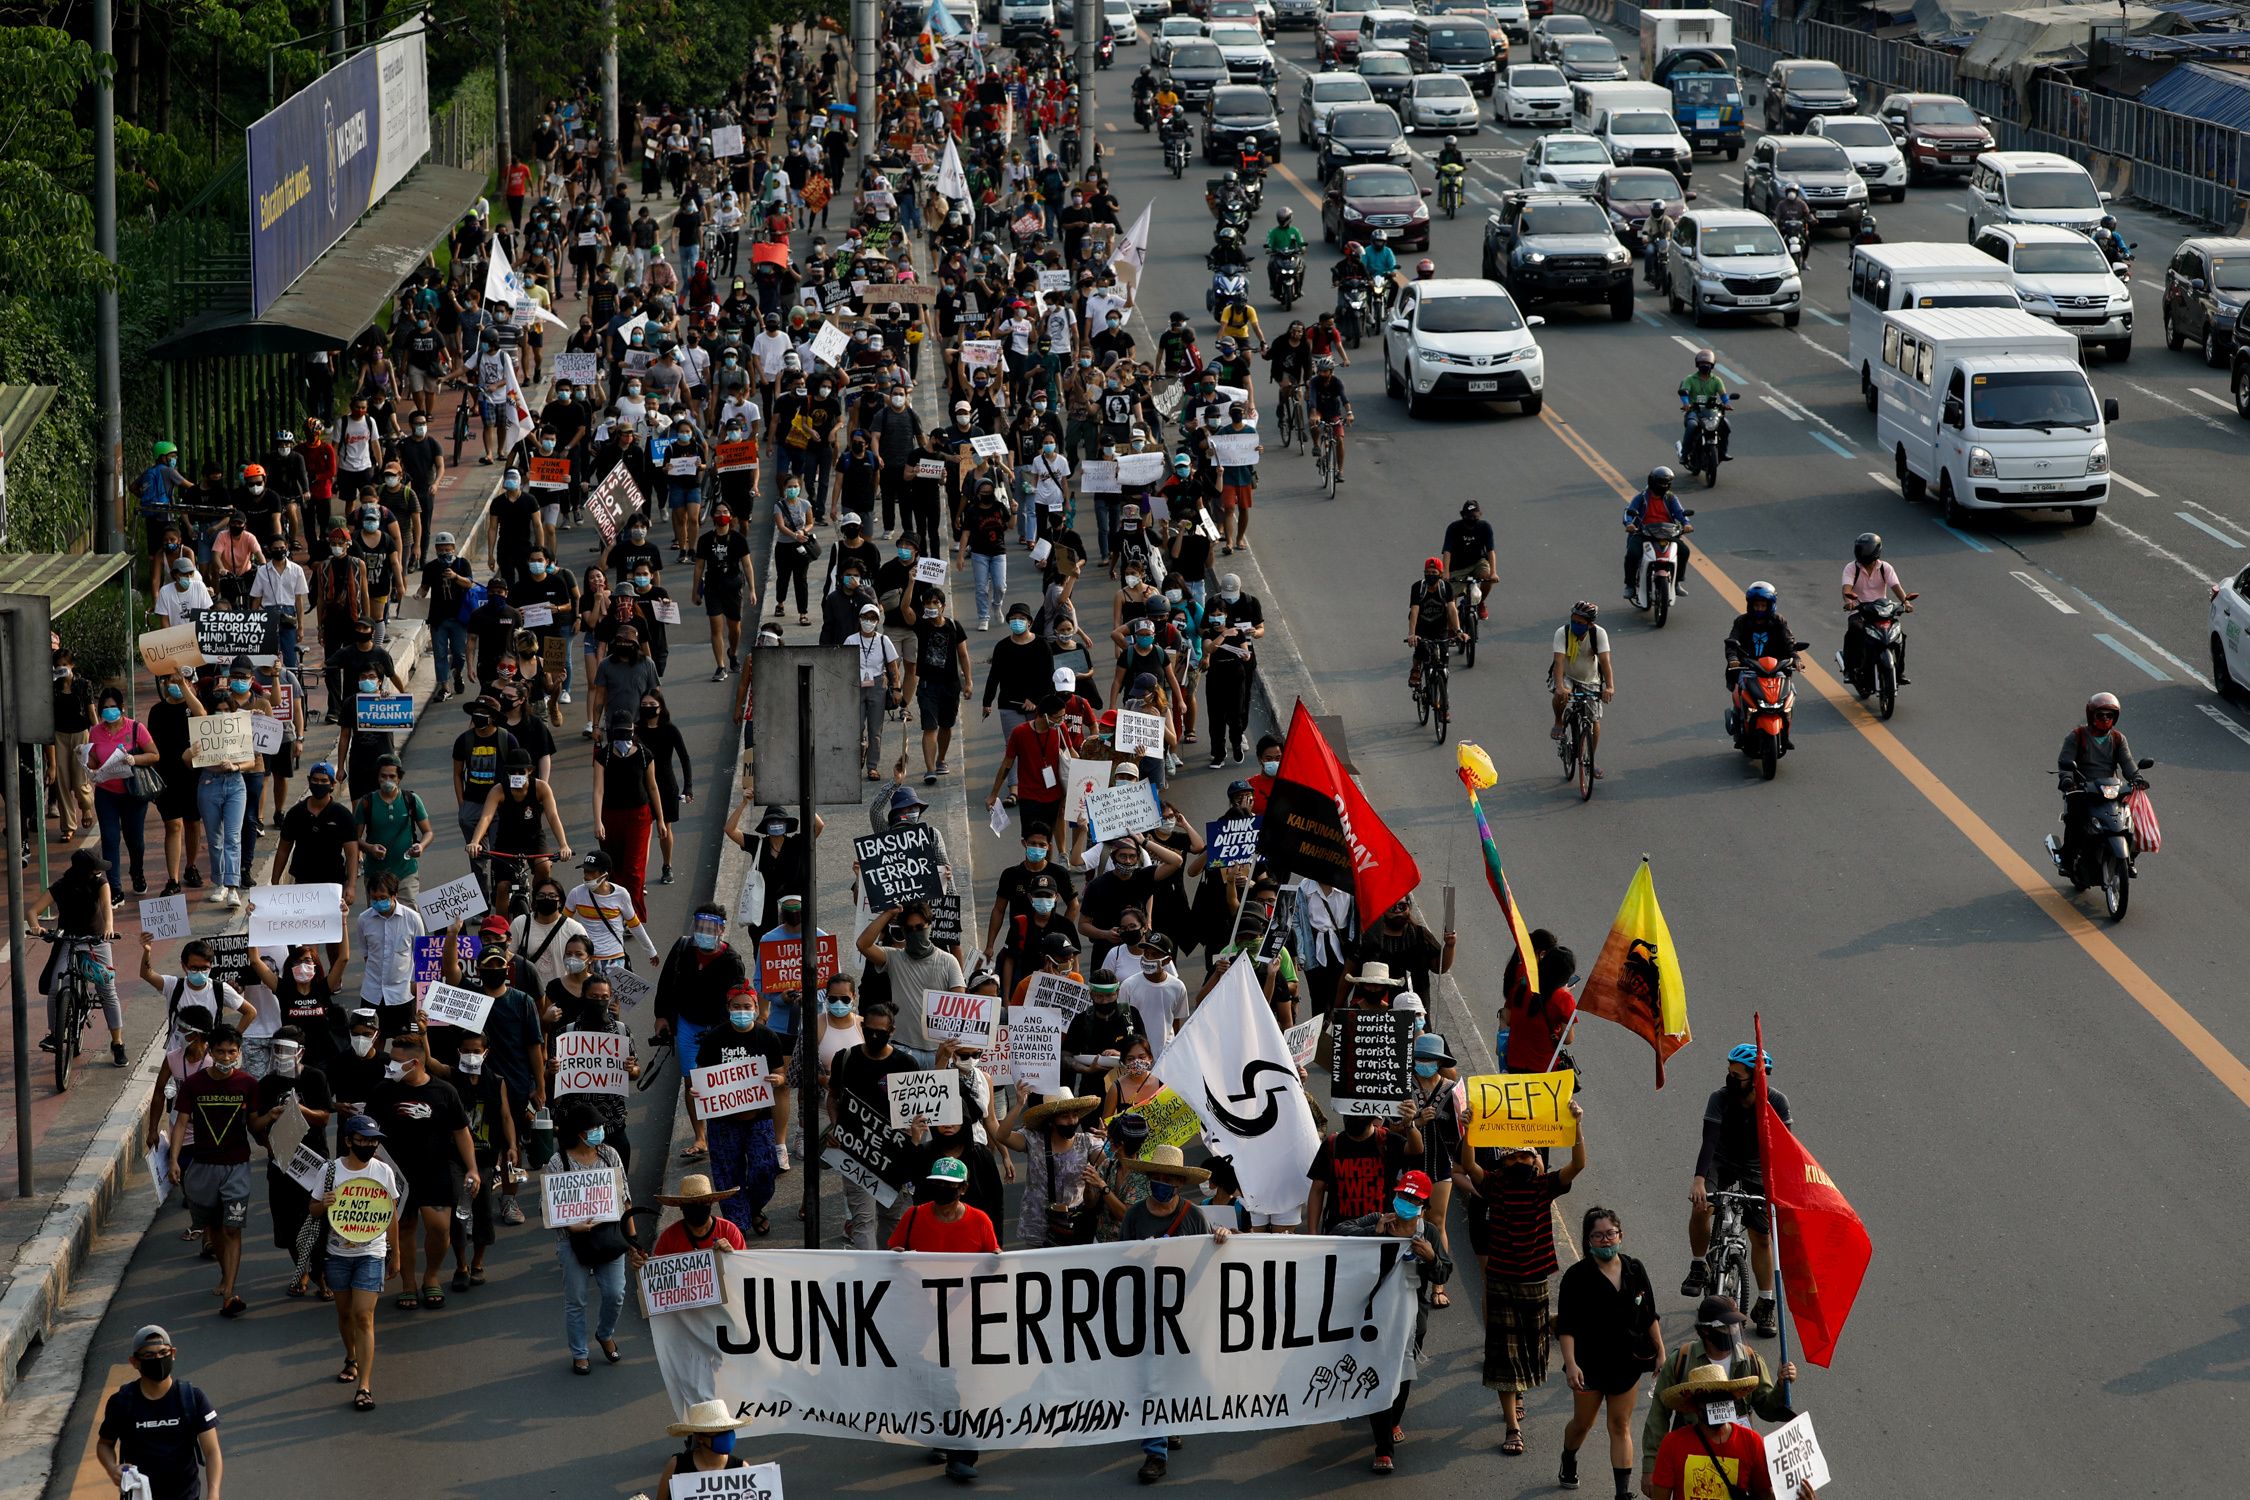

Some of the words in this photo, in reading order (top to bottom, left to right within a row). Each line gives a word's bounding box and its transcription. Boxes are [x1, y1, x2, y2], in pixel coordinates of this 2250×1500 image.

[260, 179, 285, 232] Education
[607, 474, 619, 490] IS
[613, 463, 646, 512] ACTIVISM
[599, 484, 623, 517] NOT
[919, 564, 945, 574] TERROR
[924, 560, 941, 568] JUNK
[923, 570, 939, 578] BILL!
[199, 612, 245, 623] ESTADO
[247, 612, 268, 623] ANG
[198, 632, 227, 644] HINDI
[230, 632, 264, 644] TAYO!
[369, 703, 401, 712] FIGHT
[200, 716, 242, 736] OUST
[1123, 714, 1133, 724] STOP
[1134, 715, 1142, 725] THE
[1142, 717, 1160, 729] KILLINGS
[1123, 724, 1133, 734] STOP
[1134, 725, 1142, 735] THE
[1142, 727, 1160, 739] KILLINGS
[1123, 734, 1133, 744] STOP
[1142, 737, 1160, 749] KILLINGS
[1090, 791, 1115, 805] KAPAG
[1116, 782, 1148, 797] NAMULAT
[1113, 797, 1122, 805] NA
[1142, 805, 1153, 813] NA
[1102, 824, 1116, 833] ANG
[1223, 817, 1255, 833] JUNK
[856, 827, 930, 860] IBASURA
[1220, 845, 1240, 858] EO
[1240, 843, 1256, 856] 70
[881, 852, 907, 865] ANG
[866, 857, 932, 886] TERROR
[438, 882, 467, 900] JUNK
[882, 876, 923, 896] BILL
[149, 899, 174, 914] JUNK
[269, 891, 320, 906] ACTIVISM
[422, 896, 462, 916] TERROR
[462, 889, 480, 902] BILL
[944, 896, 957, 908] ALL
[143, 916, 166, 927] TERROR
[167, 912, 181, 922] BILL
[444, 903, 470, 921] NOW
[158, 923, 178, 938] NOW
[268, 919, 328, 933] TERRORISM
[938, 920, 954, 930] AND
[614, 971, 650, 995] ACTIVISM
[617, 983, 638, 997] NOT
[1039, 976, 1056, 990] JUNK
[1056, 979, 1081, 998] TERROR
[433, 994, 447, 1004] JUNK
[447, 998, 467, 1009] TERROR
[466, 1004, 481, 1013] BILL!
[436, 986, 450, 996] JUNK
[450, 989, 470, 1001] TERROR
[469, 996, 484, 1005] BILL!
[1035, 988, 1053, 1002] JUNK
[1053, 992, 1078, 1010] TERROR
[289, 1006, 324, 1016] POWERFUL
[430, 1003, 444, 1012] JUNK
[443, 1006, 463, 1018] TERROR
[463, 1012, 477, 1022] BILL!
[933, 995, 987, 1020] JUNK
[928, 1016, 963, 1033] TERROR
[962, 1020, 988, 1036] BILL!
[1023, 1016, 1042, 1024] ANG
[1008, 1025, 1060, 1034] PAGSASAKA
[1013, 1034, 1025, 1042] AY
[1026, 1034, 1052, 1042] HINDI
[560, 1035, 620, 1059] JUNK!
[721, 1046, 747, 1056] Karl&
[1012, 1043, 1053, 1052] GAWAING
[1332, 1023, 1343, 1082] PATALSIKIN
[1010, 1051, 1057, 1062] TERORISTA
[561, 1071, 623, 1091] NOW!!!
[707, 1062, 759, 1089] DUTERTE
[897, 1072, 936, 1087] JUNK
[700, 1085, 769, 1114] TERORISTA
[891, 1084, 950, 1103] TERROR
[1481, 1079, 1562, 1123] DEFY
[900, 1100, 942, 1118] BILL!
[1350, 1101, 1391, 1115] SAKA
[862, 1125, 883, 1149] TE
[834, 1124, 892, 1171] RORIST
[290, 1159, 311, 1175] NOW!
[549, 1172, 613, 1192] MAGSASAKA
[840, 1158, 880, 1196] SAKA
[342, 1186, 387, 1199] ACTIVISM
[553, 1188, 583, 1206] KAMI,
[585, 1185, 613, 1202] HINDI
[350, 1199, 370, 1210] NOT
[555, 1200, 614, 1220] TERORISTA!
[332, 1210, 392, 1224] TERRORISM!
[643, 1253, 712, 1280] MAGSASAKA
[648, 1275, 680, 1294] KAMI,
[682, 1268, 712, 1288] HINDI
[652, 1283, 714, 1308] TERORISTA!
[716, 1277, 898, 1368] JUNK
[922, 1265, 1190, 1368] TERROR
[1220, 1242, 1400, 1354] BILL!
[1141, 1394, 1290, 1427] PAMALAKAYA
[136, 1418, 180, 1429] HEAD
[1777, 1424, 1803, 1454] JUNK
[696, 1473, 757, 1494] JUNK
[1785, 1461, 1814, 1491] BILL!
